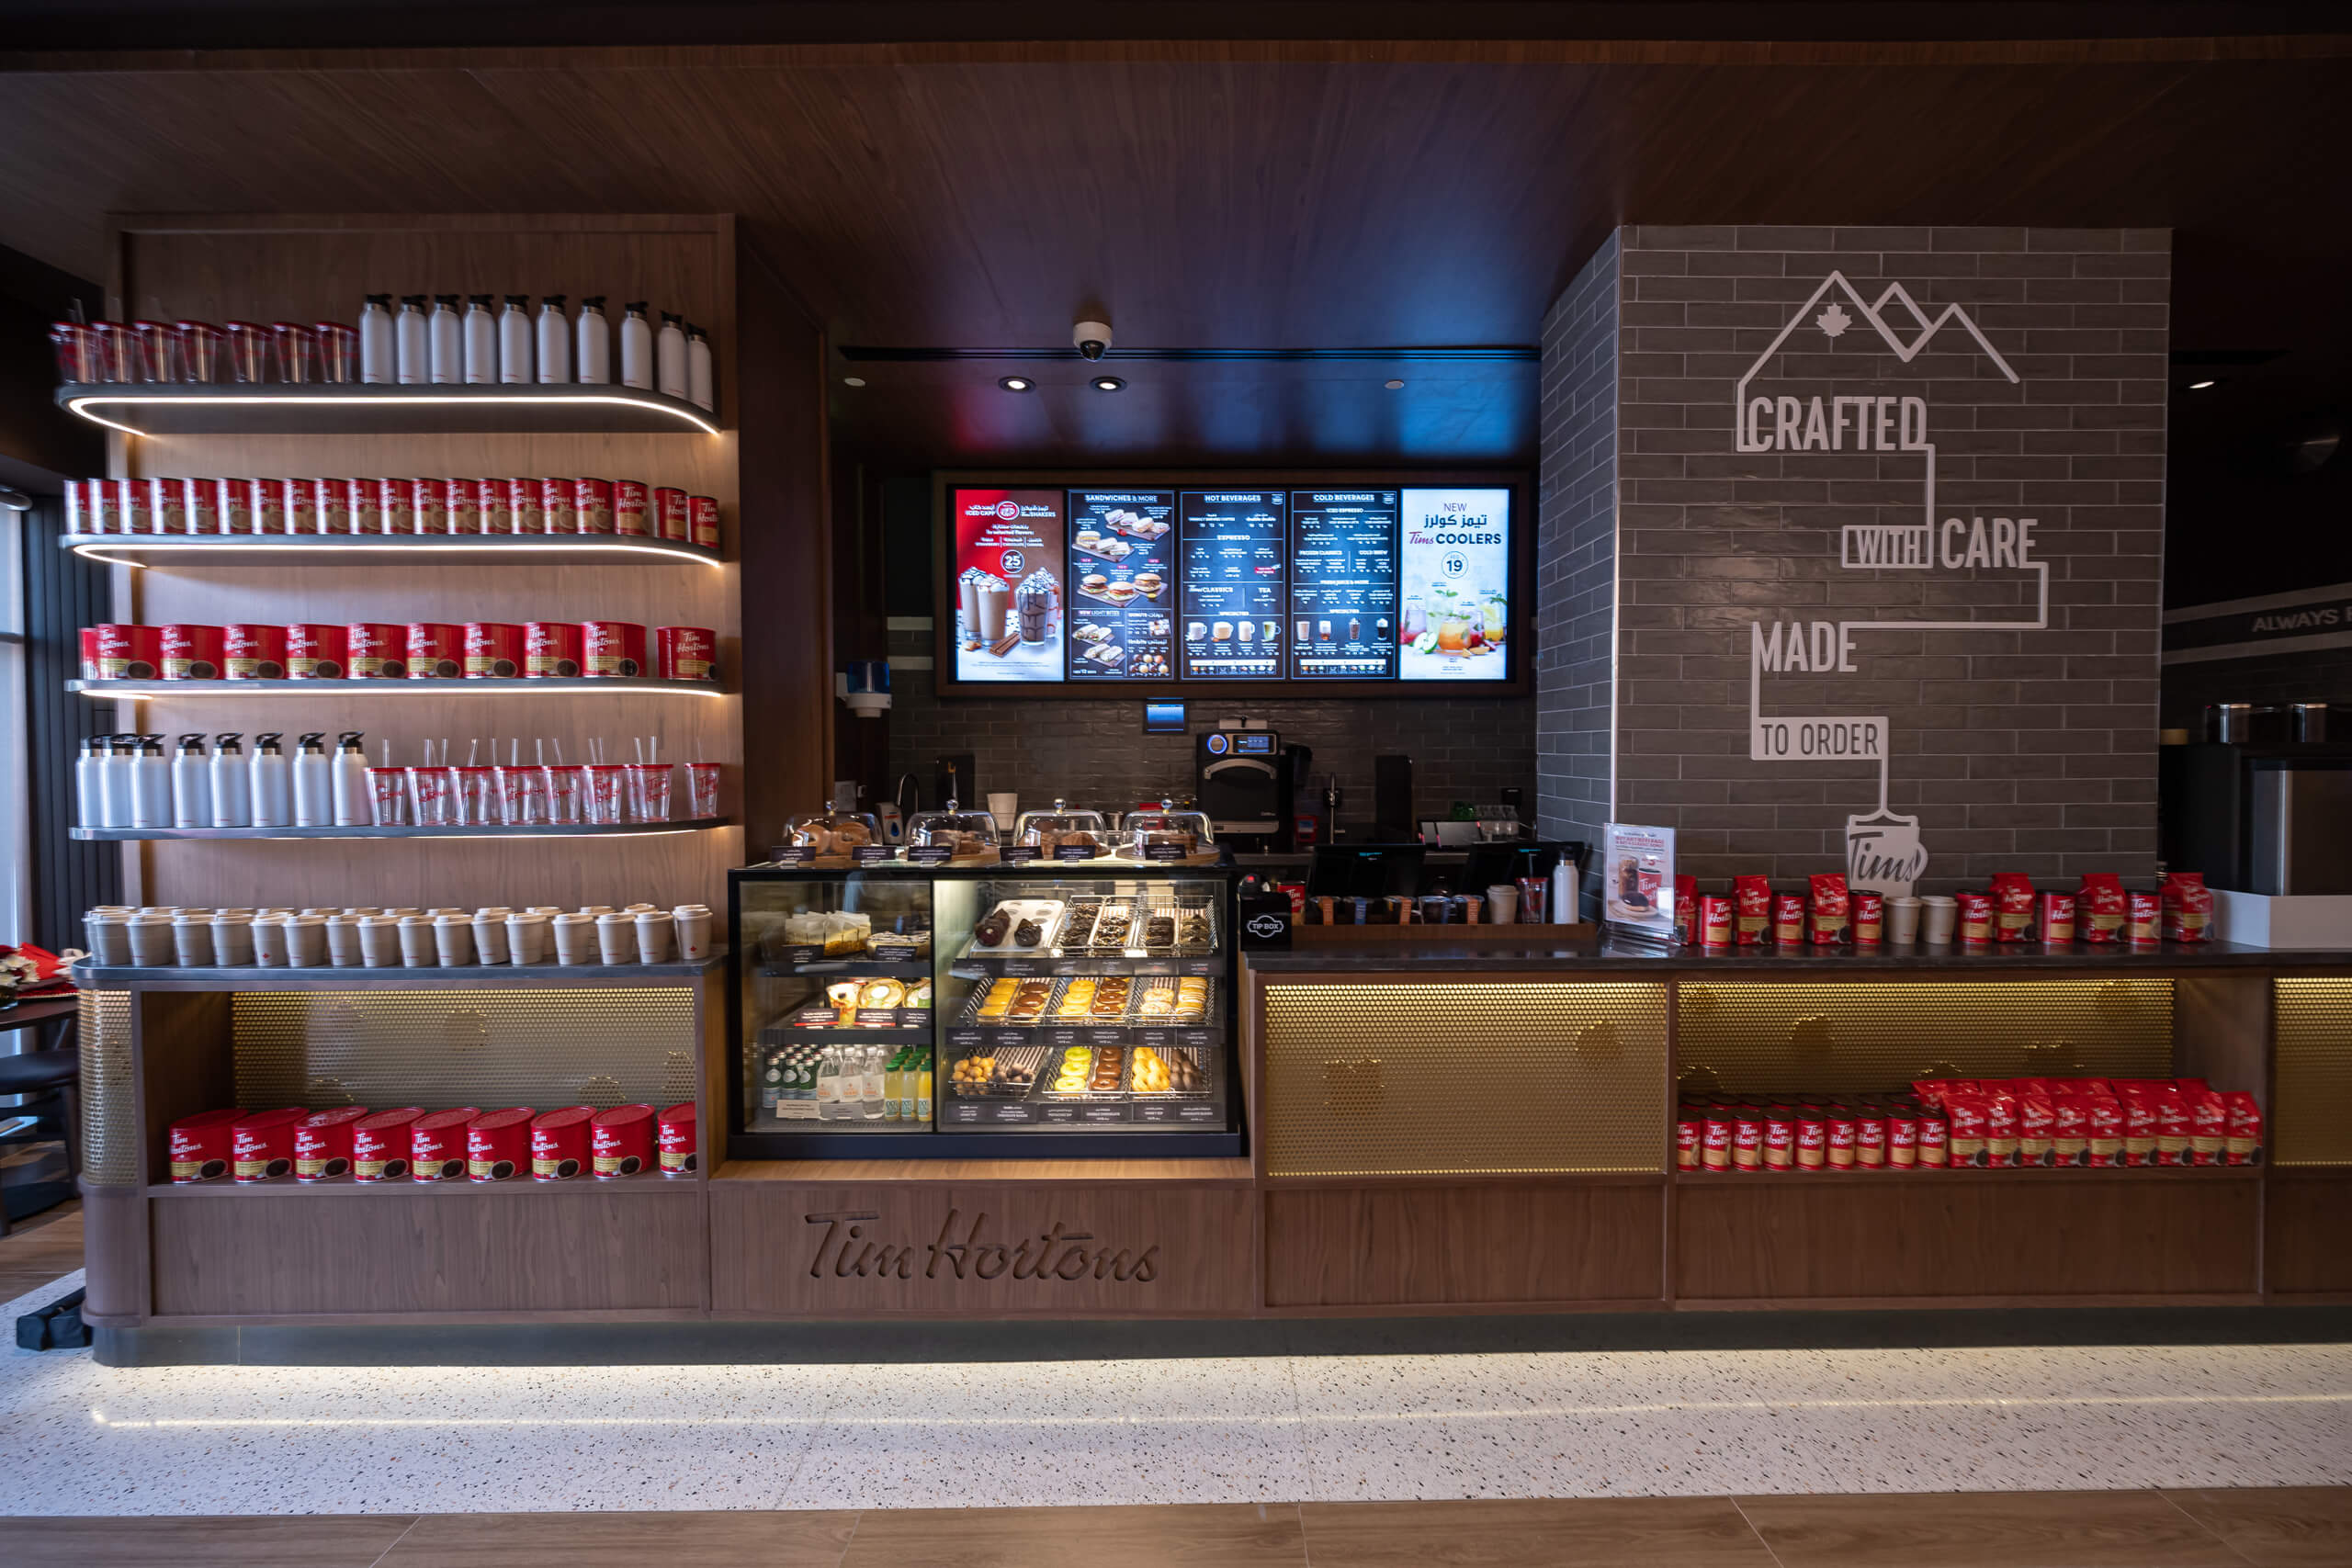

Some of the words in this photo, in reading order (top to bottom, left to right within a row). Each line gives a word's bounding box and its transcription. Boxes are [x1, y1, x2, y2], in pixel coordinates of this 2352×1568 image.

[1747, 396, 1928, 451] CRAFTED
[576, 483, 593, 495] Tim
[623, 486, 642, 498] Tim
[617, 498, 648, 509] Horton
[1443, 503, 1467, 512] NEW
[1424, 514, 1457, 528] كولرز
[1461, 514, 1487, 528] تيمز
[1408, 531, 1433, 544] Tims
[1436, 534, 1501, 544] COOLERS
[1857, 529, 1921, 564] WITH
[1940, 517, 2038, 569] CARE
[1004, 555, 1021, 566] 25
[1446, 559, 1463, 571] 19
[2252, 609, 2339, 633] ALWAYS
[100, 628, 116, 640] Tim
[163, 629, 177, 640] Tim
[229, 628, 245, 639] Tim
[289, 628, 304, 639] Tim
[352, 627, 370, 638] Tim
[411, 627, 425, 638] Tim
[469, 627, 483, 638] Tim
[528, 626, 546, 637] Tim
[591, 626, 607, 637] Tim
[684, 631, 700, 642] Tim
[466, 637, 496, 649] Hortons
[527, 637, 558, 649] Hortons
[587, 637, 621, 649] Hortons
[676, 641, 709, 652] Hortons
[1751, 621, 1858, 672] MADE
[1761, 724, 1789, 755] TO
[1801, 724, 1879, 756] ORDER
[1849, 831, 1921, 882] Tims
[1746, 888, 1758, 897] Tim
[1821, 887, 1835, 897] Tim
[1742, 897, 1770, 906] Hortons
[1783, 900, 1802, 910] Tim
[2131, 897, 2153, 908] Tim
[595, 1129, 609, 1140] Tim
[662, 1124, 674, 1135] Tim
[171, 1133, 187, 1145] Tim
[235, 1133, 253, 1145] Tim
[296, 1132, 312, 1143] Tim
[355, 1133, 372, 1145] Tim
[414, 1133, 430, 1145] Tim
[468, 1133, 481, 1144] Tim
[533, 1131, 548, 1142] Tim
[659, 1134, 686, 1145] Hortons
[234, 1143, 267, 1155] Hortons
[295, 1141, 326, 1153] Hortons
[354, 1142, 386, 1154] Hortons
[413, 1142, 443, 1154] Hortons
[532, 1141, 559, 1152] Hortons
[593, 1139, 621, 1150] Hortons
[805, 1209, 916, 1279] Tim
[926, 1208, 1160, 1282] Hortons
